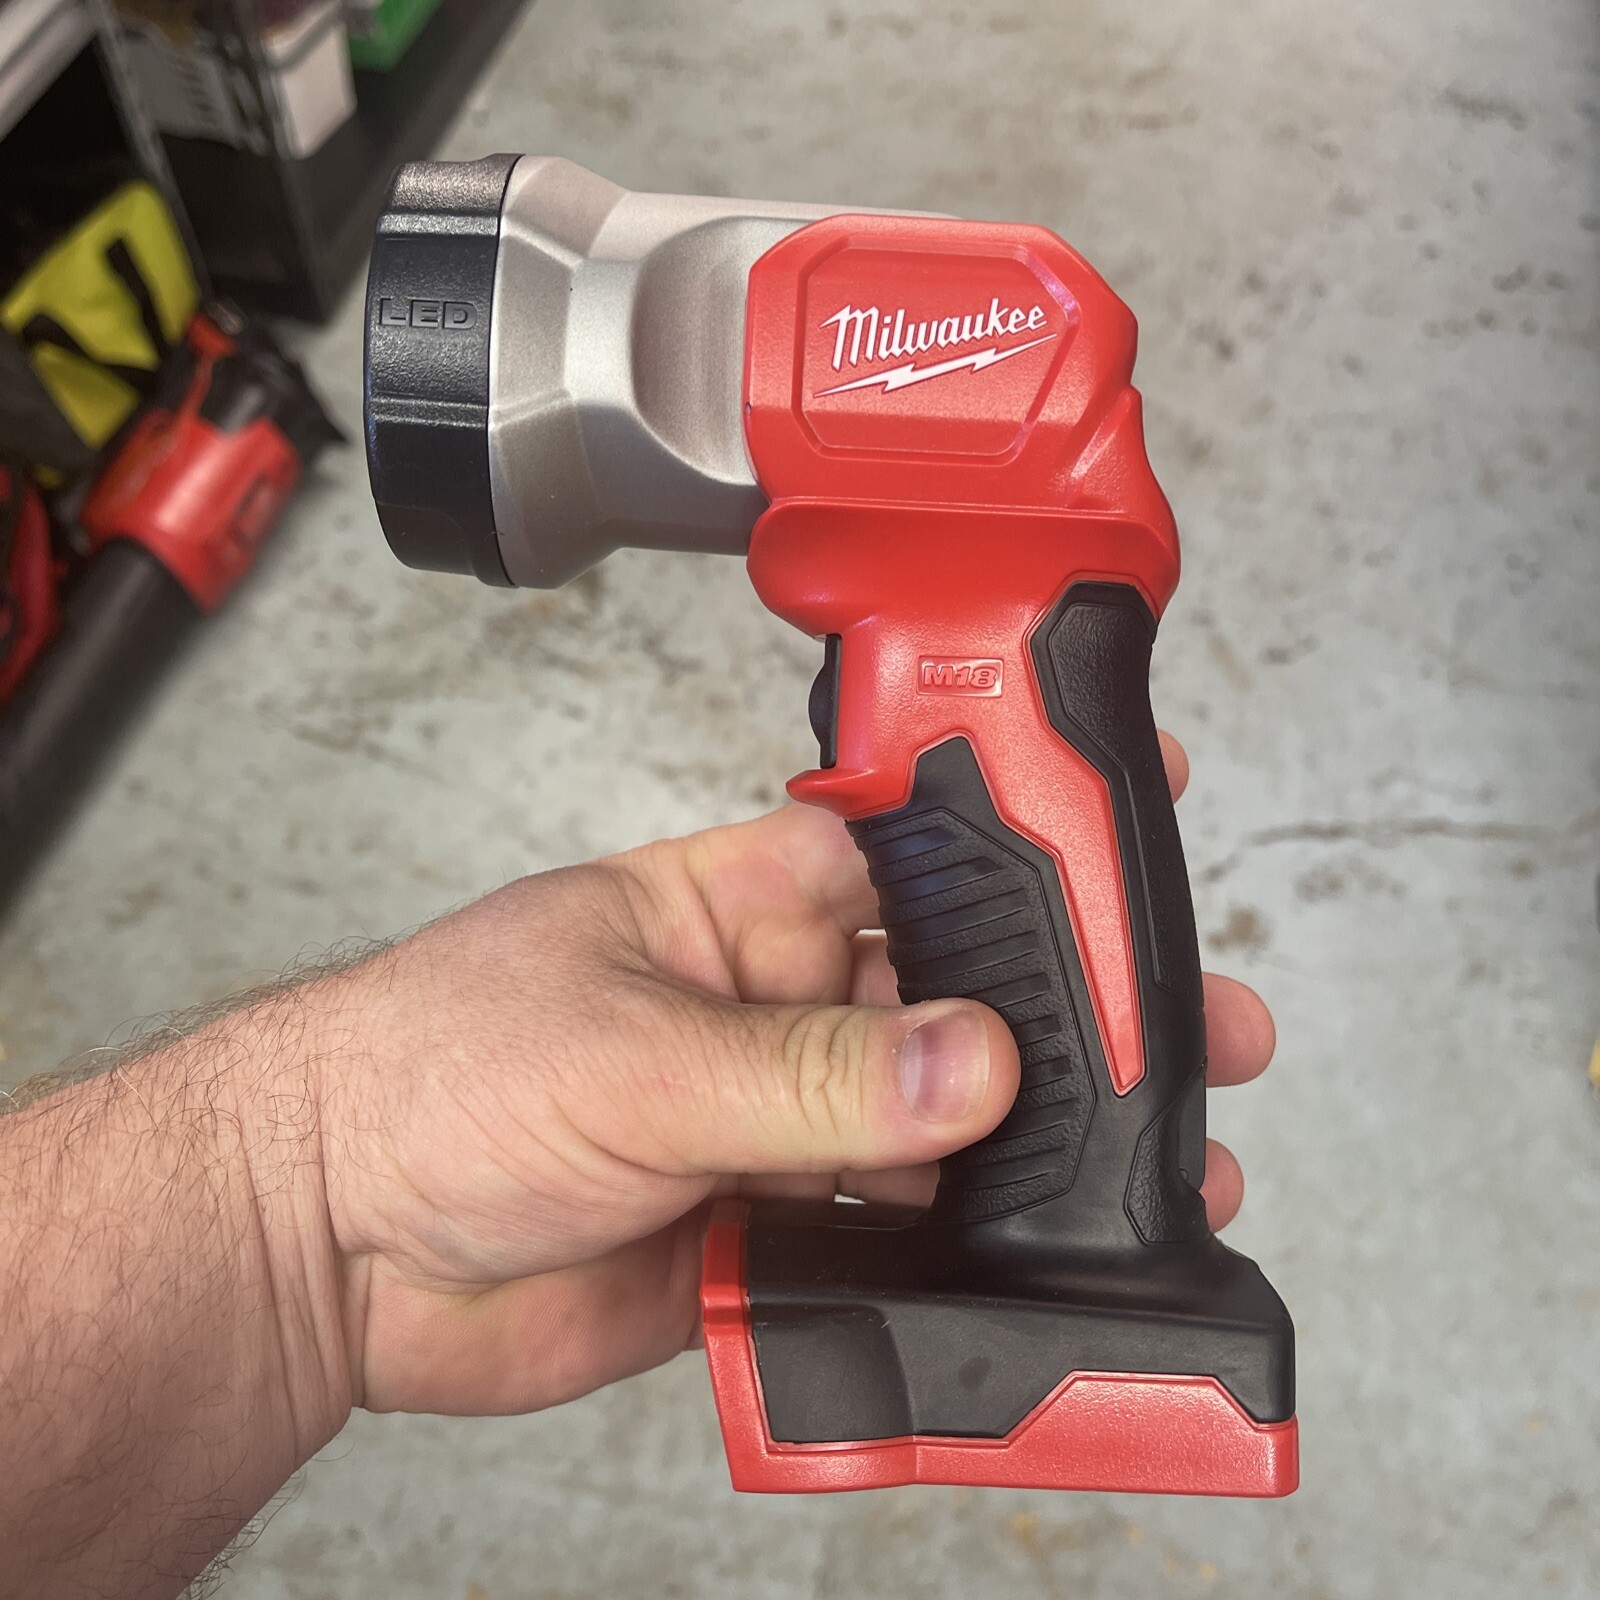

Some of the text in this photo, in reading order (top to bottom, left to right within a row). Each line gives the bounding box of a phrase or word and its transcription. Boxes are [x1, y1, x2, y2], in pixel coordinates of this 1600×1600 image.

[379, 297, 478, 330] LED
[820, 297, 1047, 371] Milwaukee
[923, 665, 998, 689] M18
